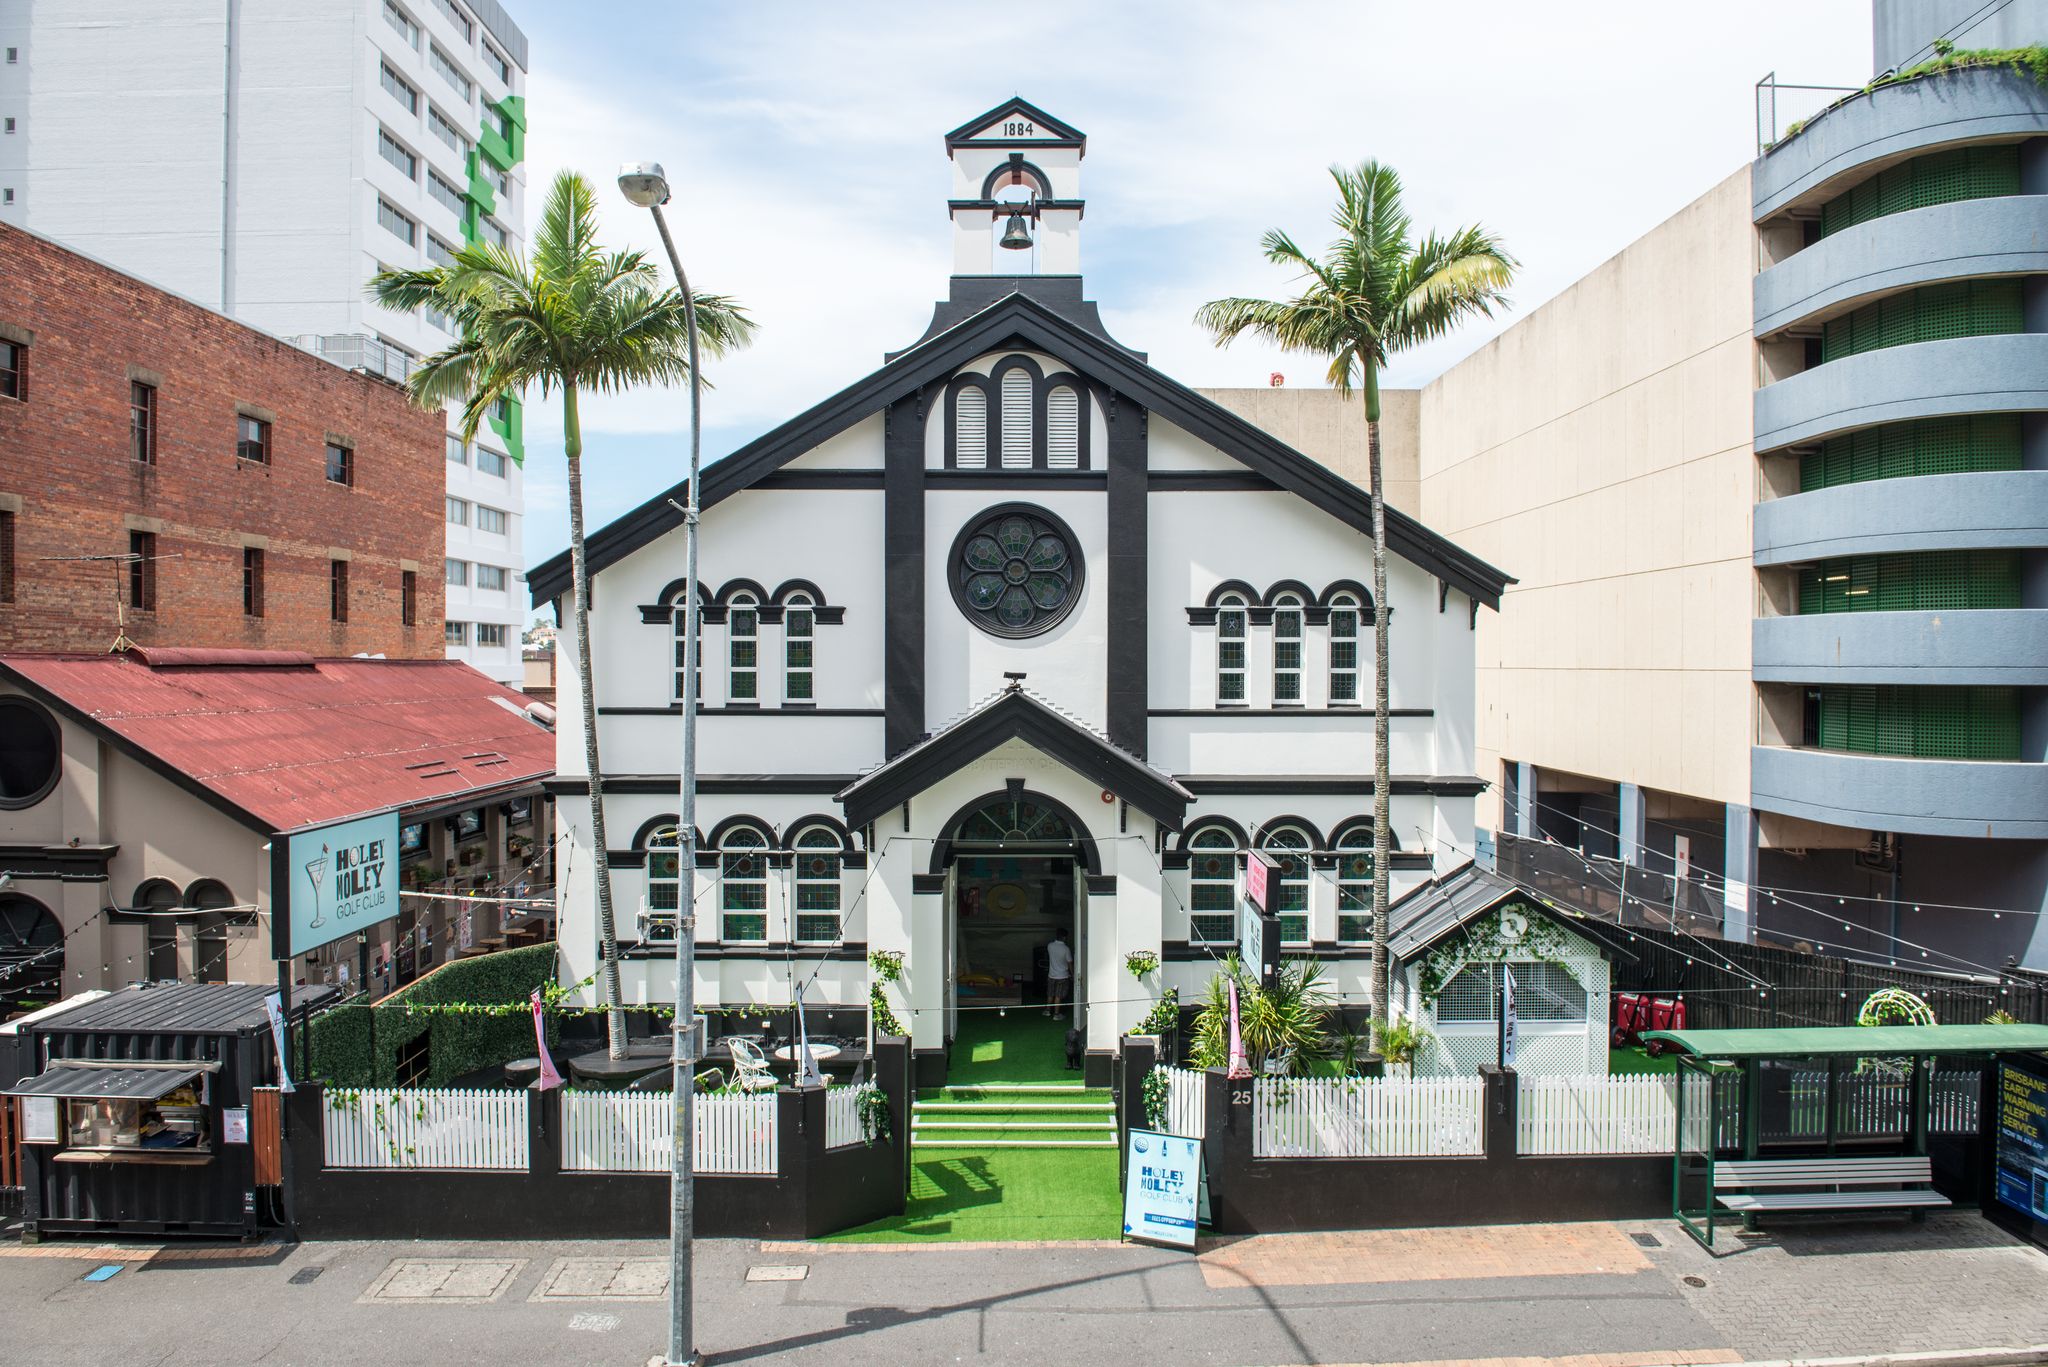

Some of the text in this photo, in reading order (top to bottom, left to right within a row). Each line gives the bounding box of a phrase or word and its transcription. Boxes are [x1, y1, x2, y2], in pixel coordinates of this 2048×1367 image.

[1004, 122, 1034, 136] 1884
[336, 839, 385, 871] HOLEY
[336, 862, 385, 901] MOLEY
[336, 891, 386, 919] GOLF CLUB
[1455, 945, 1571, 957] GARDEN BAR
[2004, 1068, 2047, 1093] BRISBANE
[2004, 1080, 2031, 1098] EARLY
[1232, 1090, 1251, 1105] 25
[2003, 1091, 2047, 1118] WARNING
[2003, 1104, 2030, 1122] ALERT
[2003, 1115, 2038, 1139] SERVICE
[1142, 1166, 1184, 1181] HOLEY
[1141, 1177, 1184, 1195] MOLEY
[1140, 1191, 1184, 1204] GOLF CLUB
